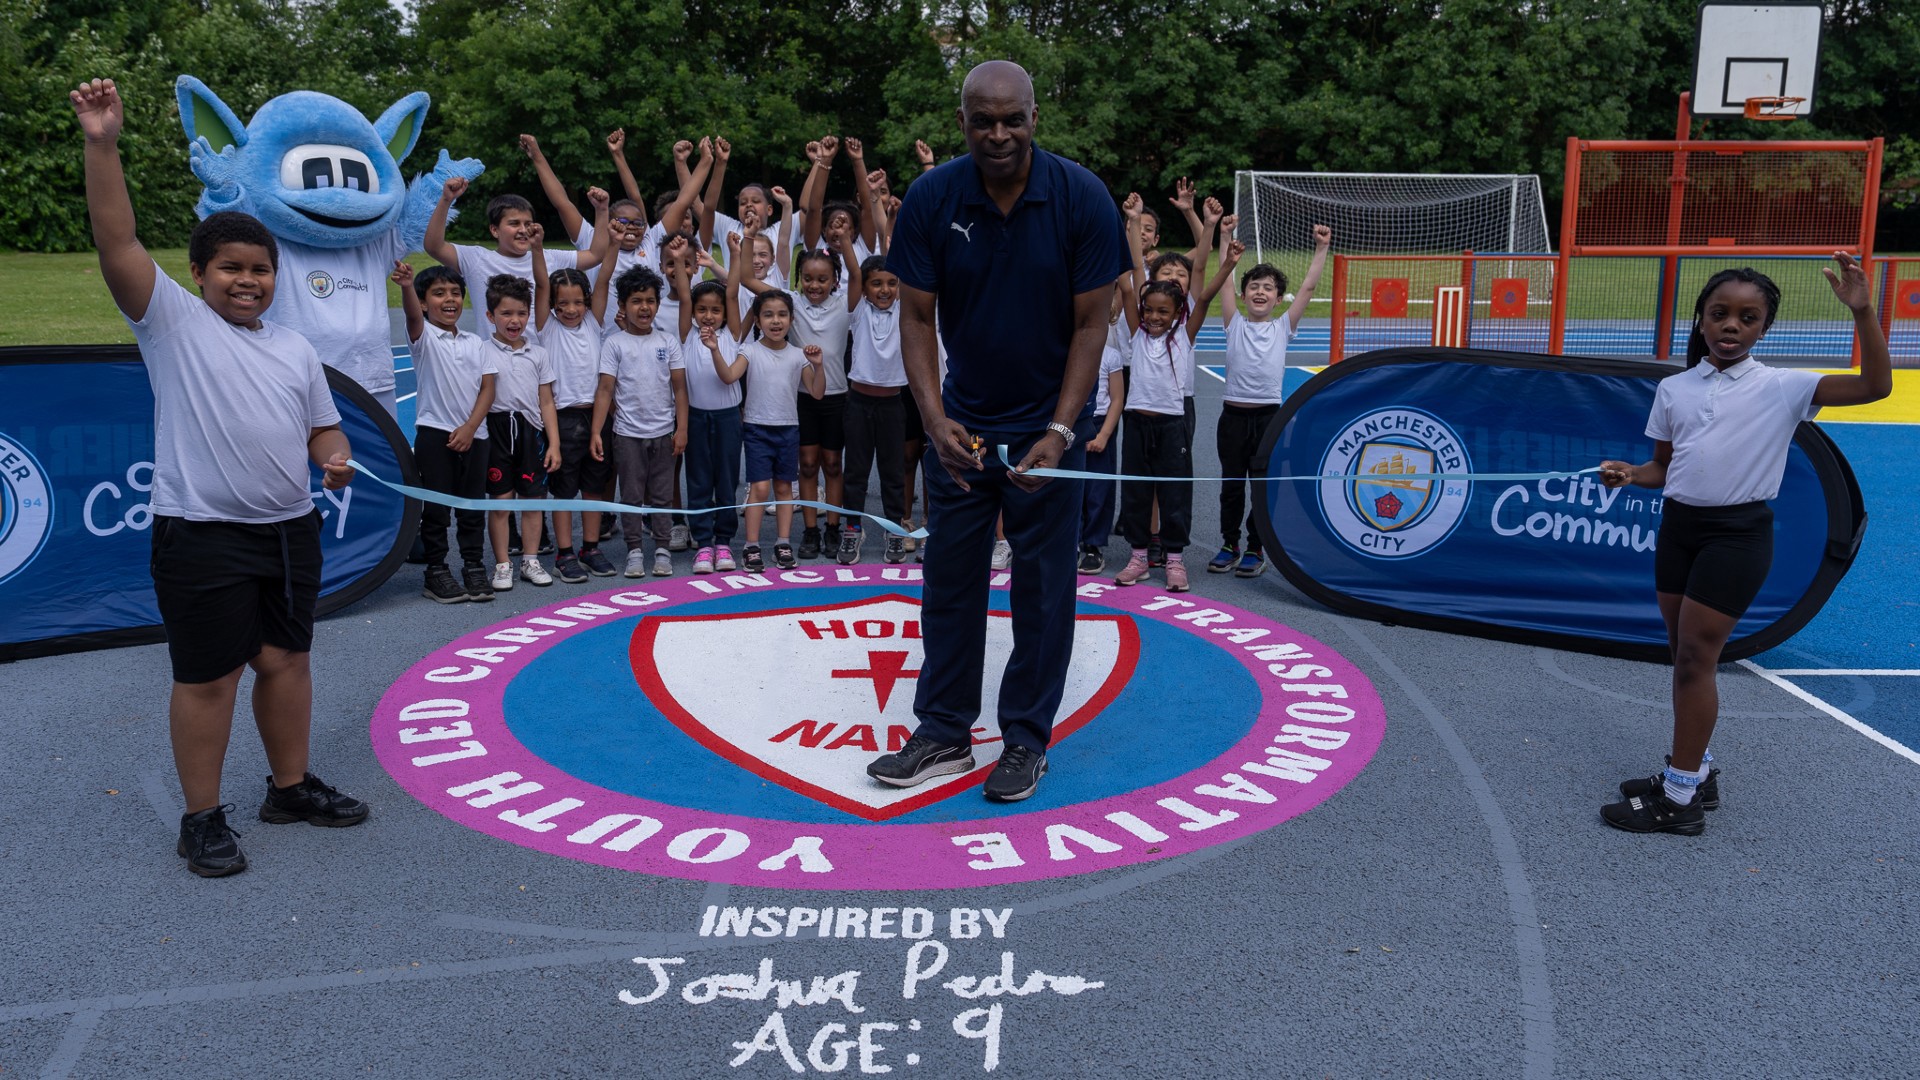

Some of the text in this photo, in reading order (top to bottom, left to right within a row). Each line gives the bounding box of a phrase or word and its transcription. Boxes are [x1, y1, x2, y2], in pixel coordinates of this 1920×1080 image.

[1338, 415, 1461, 471] MANCHESTER
[23, 498, 42, 508] 94
[1446, 487, 1463, 497] 94
[1491, 484, 1656, 552] Commu
[1625, 495, 1643, 512] in
[1360, 532, 1406, 552] CITY
[424, 591, 668, 683] CARING
[797, 619, 923, 640] HOL
[399, 698, 487, 767] LED
[951, 594, 1356, 871] TRANSFORMATIVE
[447, 770, 834, 873] YOUTH
[700, 905, 1013, 939] INSPIRED BY
[729, 1002, 1004, 1074] AGE: 9
